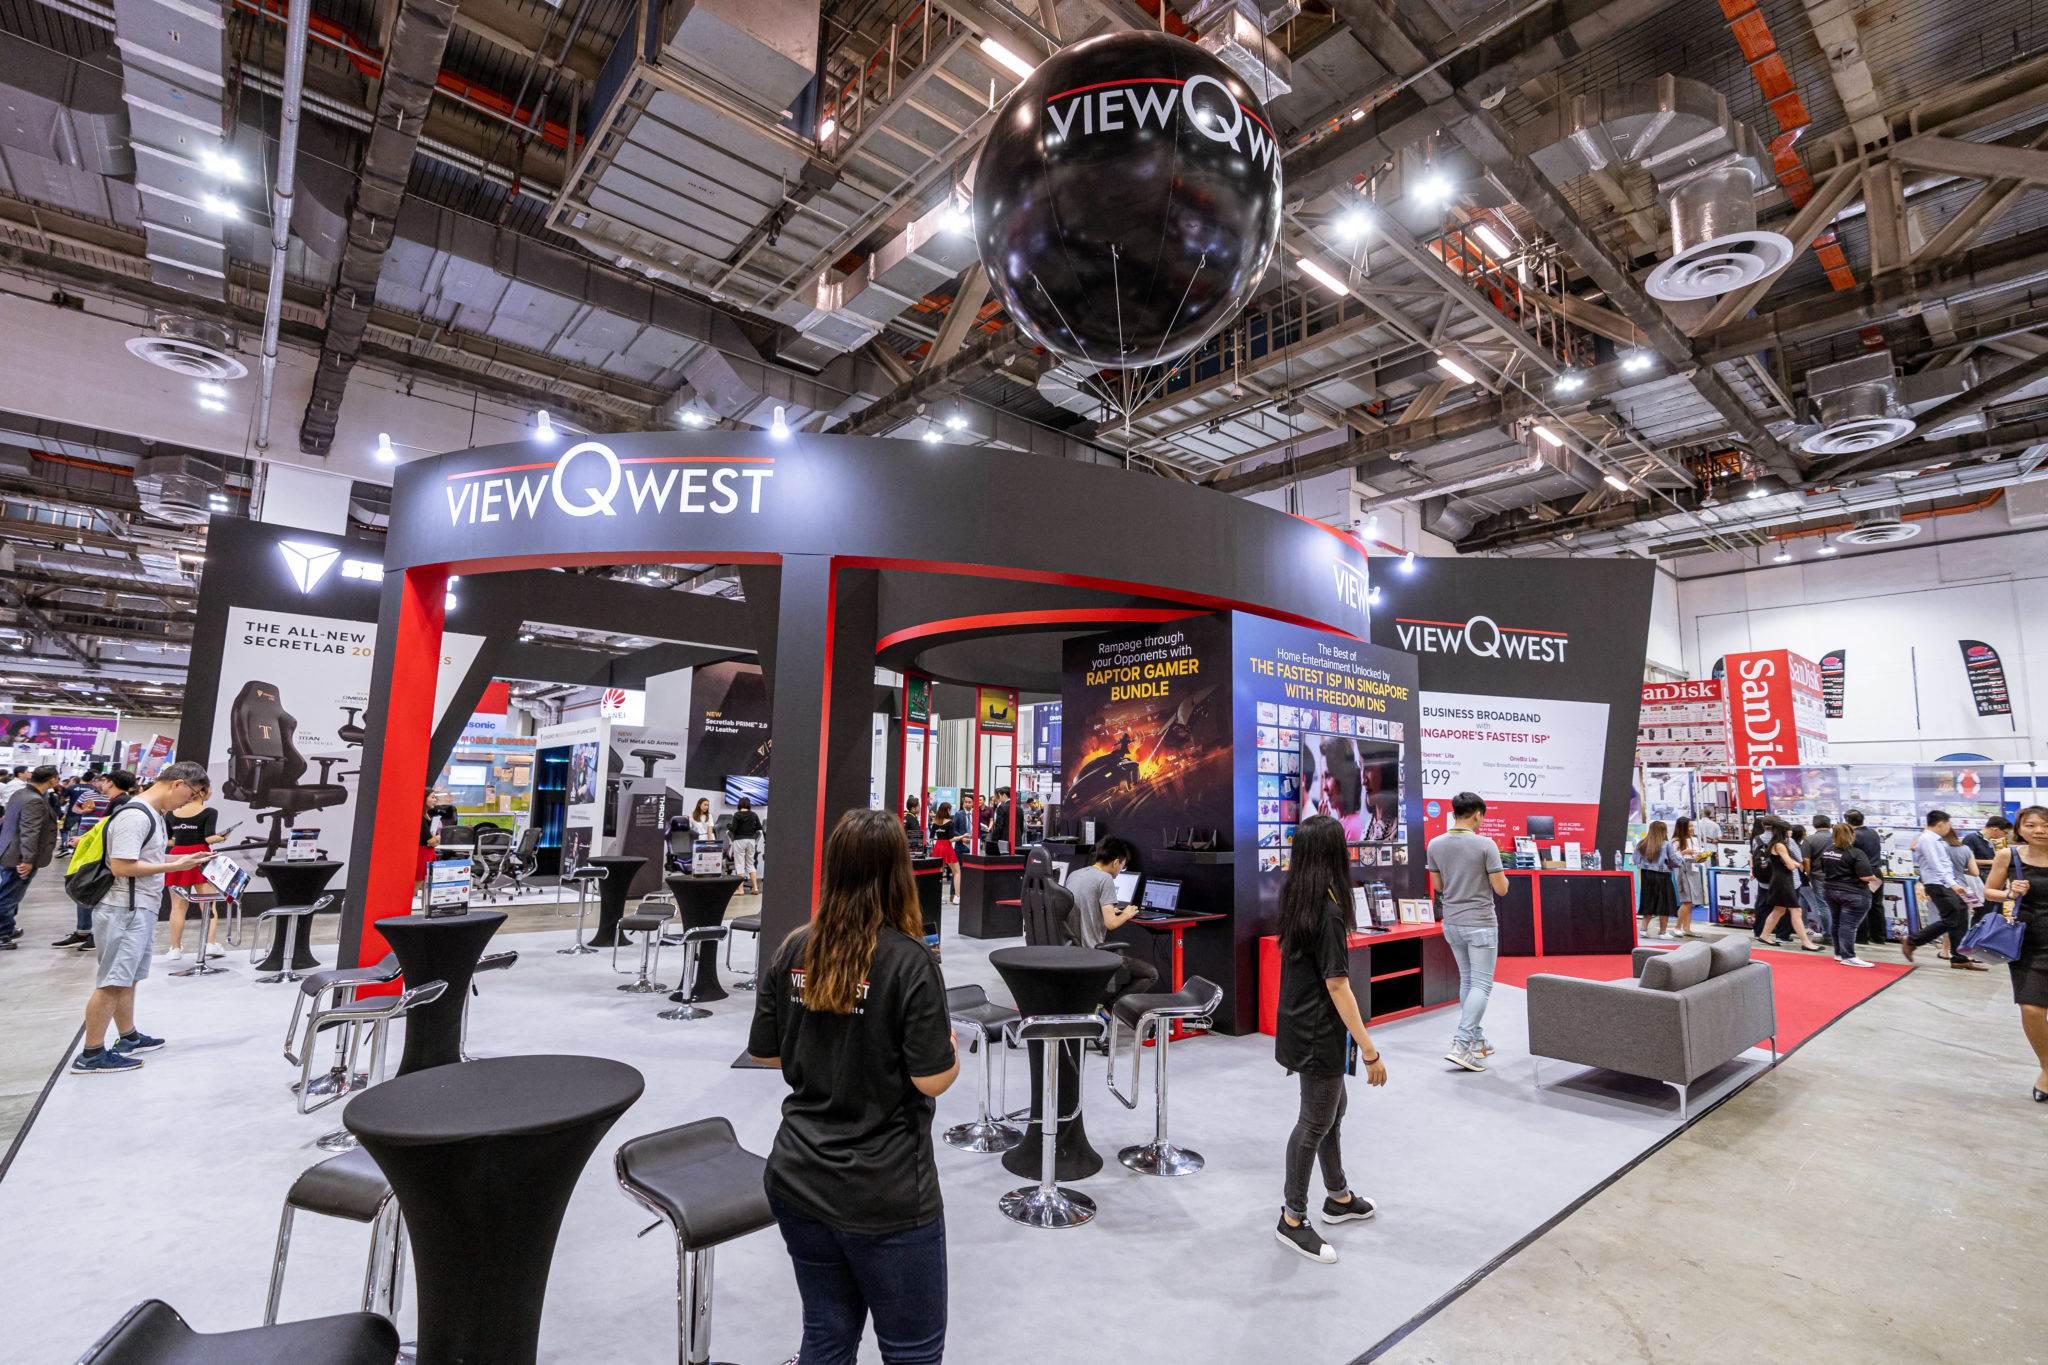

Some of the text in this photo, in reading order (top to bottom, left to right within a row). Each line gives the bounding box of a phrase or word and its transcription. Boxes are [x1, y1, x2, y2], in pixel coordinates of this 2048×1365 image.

[446, 442, 774, 527] VIEWQWEST
[245, 621, 366, 643] THE ALL-NEW
[1098, 631, 1184, 655] Rampage through
[1396, 615, 1568, 662] VIEWQWEST
[243, 635, 346, 655] SECRETLAB
[351, 646, 372, 657] 20
[1318, 642, 1357, 662] The Best of
[1092, 645, 1192, 671] your Opponents with
[1277, 648, 1391, 682] Home Entertainment Unlocked by
[1086, 658, 1199, 687] RAPTOR GAMER
[1250, 657, 1275, 676] THE
[1277, 663, 1323, 685] FASTEST
[1326, 672, 1342, 688] ISP
[1344, 675, 1355, 690] IN
[1111, 680, 1169, 701] BUNDLE
[1285, 682, 1386, 713] WITH FREEDOM DNS
[1643, 682, 1715, 701] anDisk
[466, 720, 496, 729] sonic
[705, 718, 735, 726] Secretlab
[1423, 706, 1541, 723] BUSINESS BROADBAND
[461, 736, 537, 746] MOBILE SHOWROO
[715, 726, 739, 734] Leather
[1420, 728, 1484, 741] INGAPORE'S
[1486, 731, 1529, 743] FASTEST
[657, 795, 666, 830] THRONE
